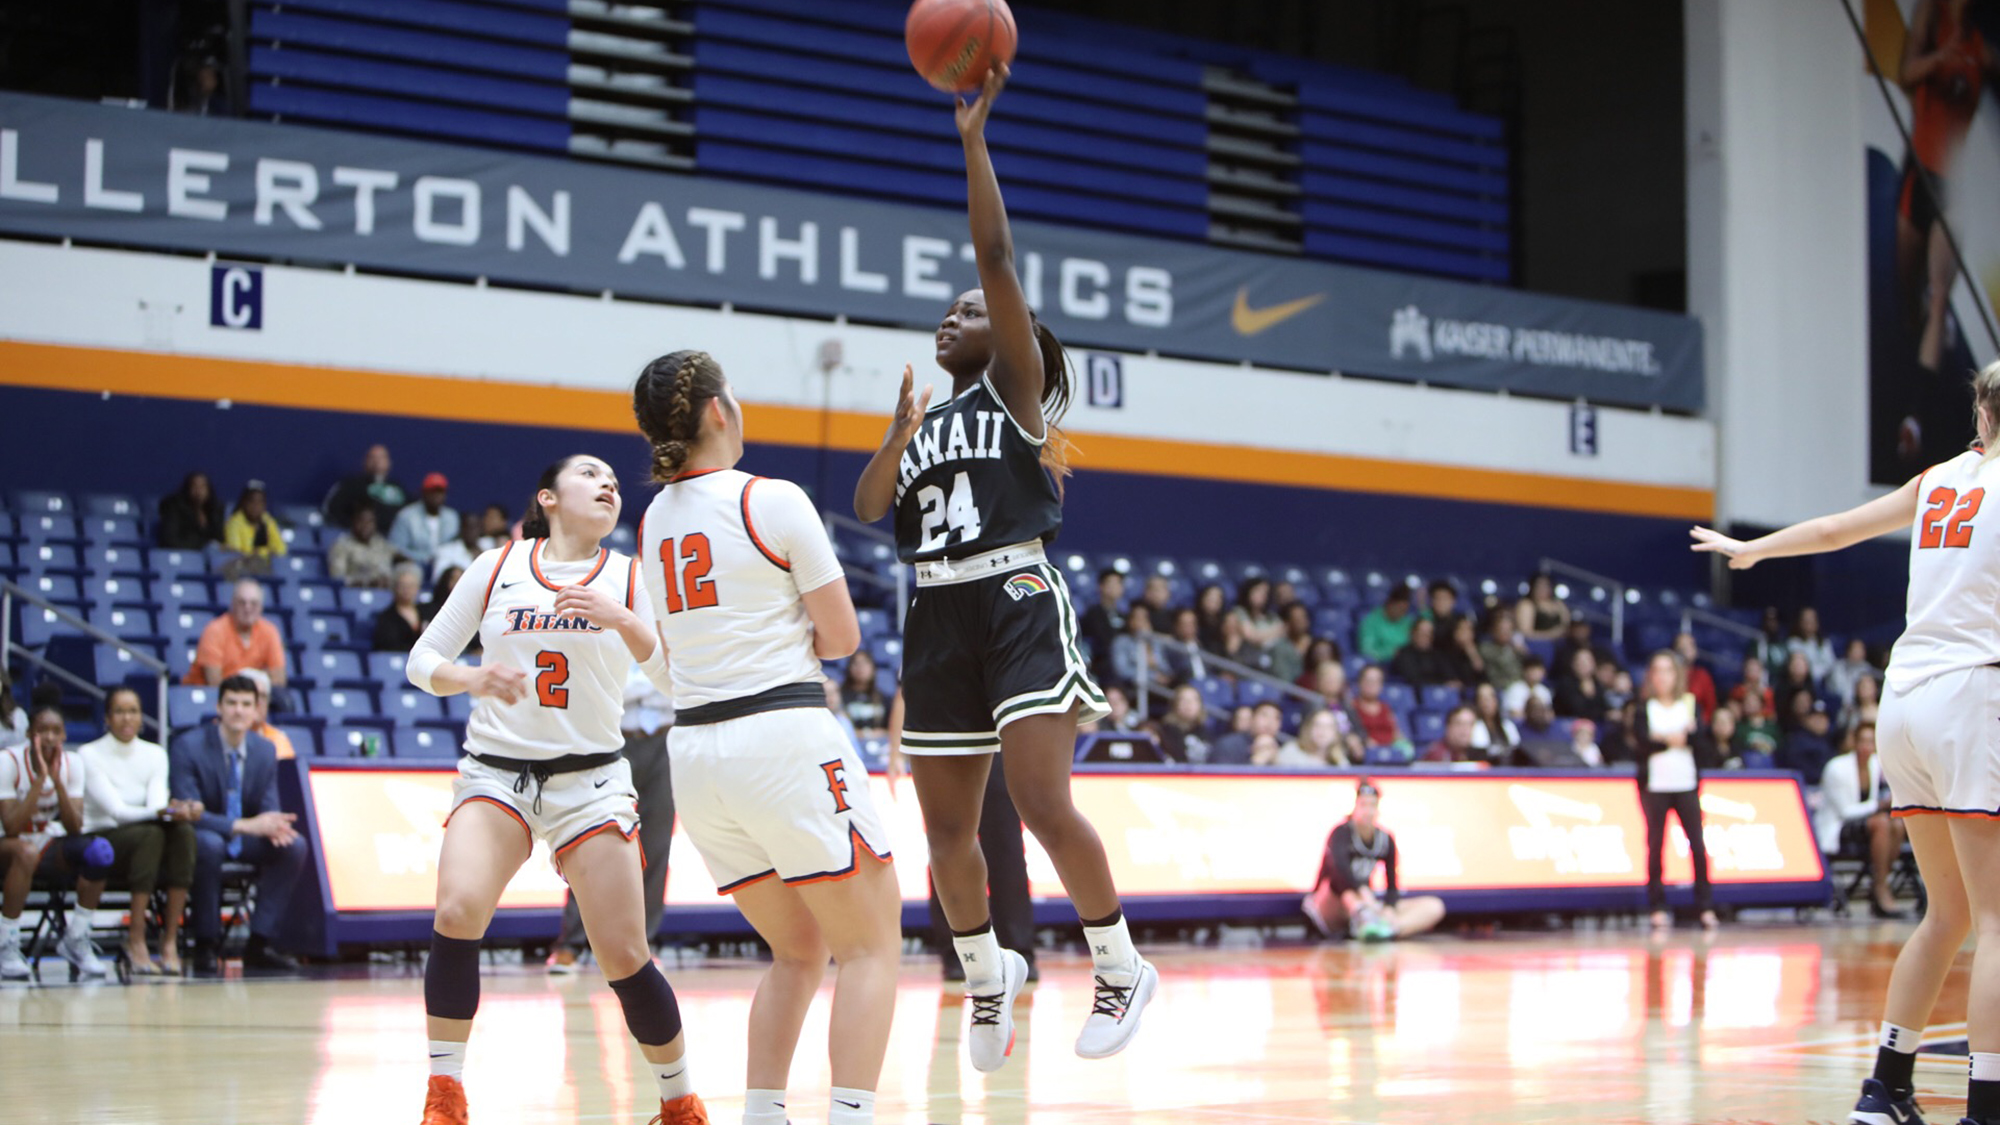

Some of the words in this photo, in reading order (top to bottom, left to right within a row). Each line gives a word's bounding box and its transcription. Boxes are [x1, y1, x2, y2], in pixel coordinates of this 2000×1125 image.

[0, 129, 571, 256] LLERTON
[618, 202, 1174, 328] ATHLEICS
[222, 268, 252, 327] C
[1092, 355, 1119, 406] D
[915, 470, 981, 553] 24
[1919, 487, 1985, 549] 22
[659, 532, 718, 614] 12
[536, 650, 569, 709] 2
[820, 758, 851, 814] F
